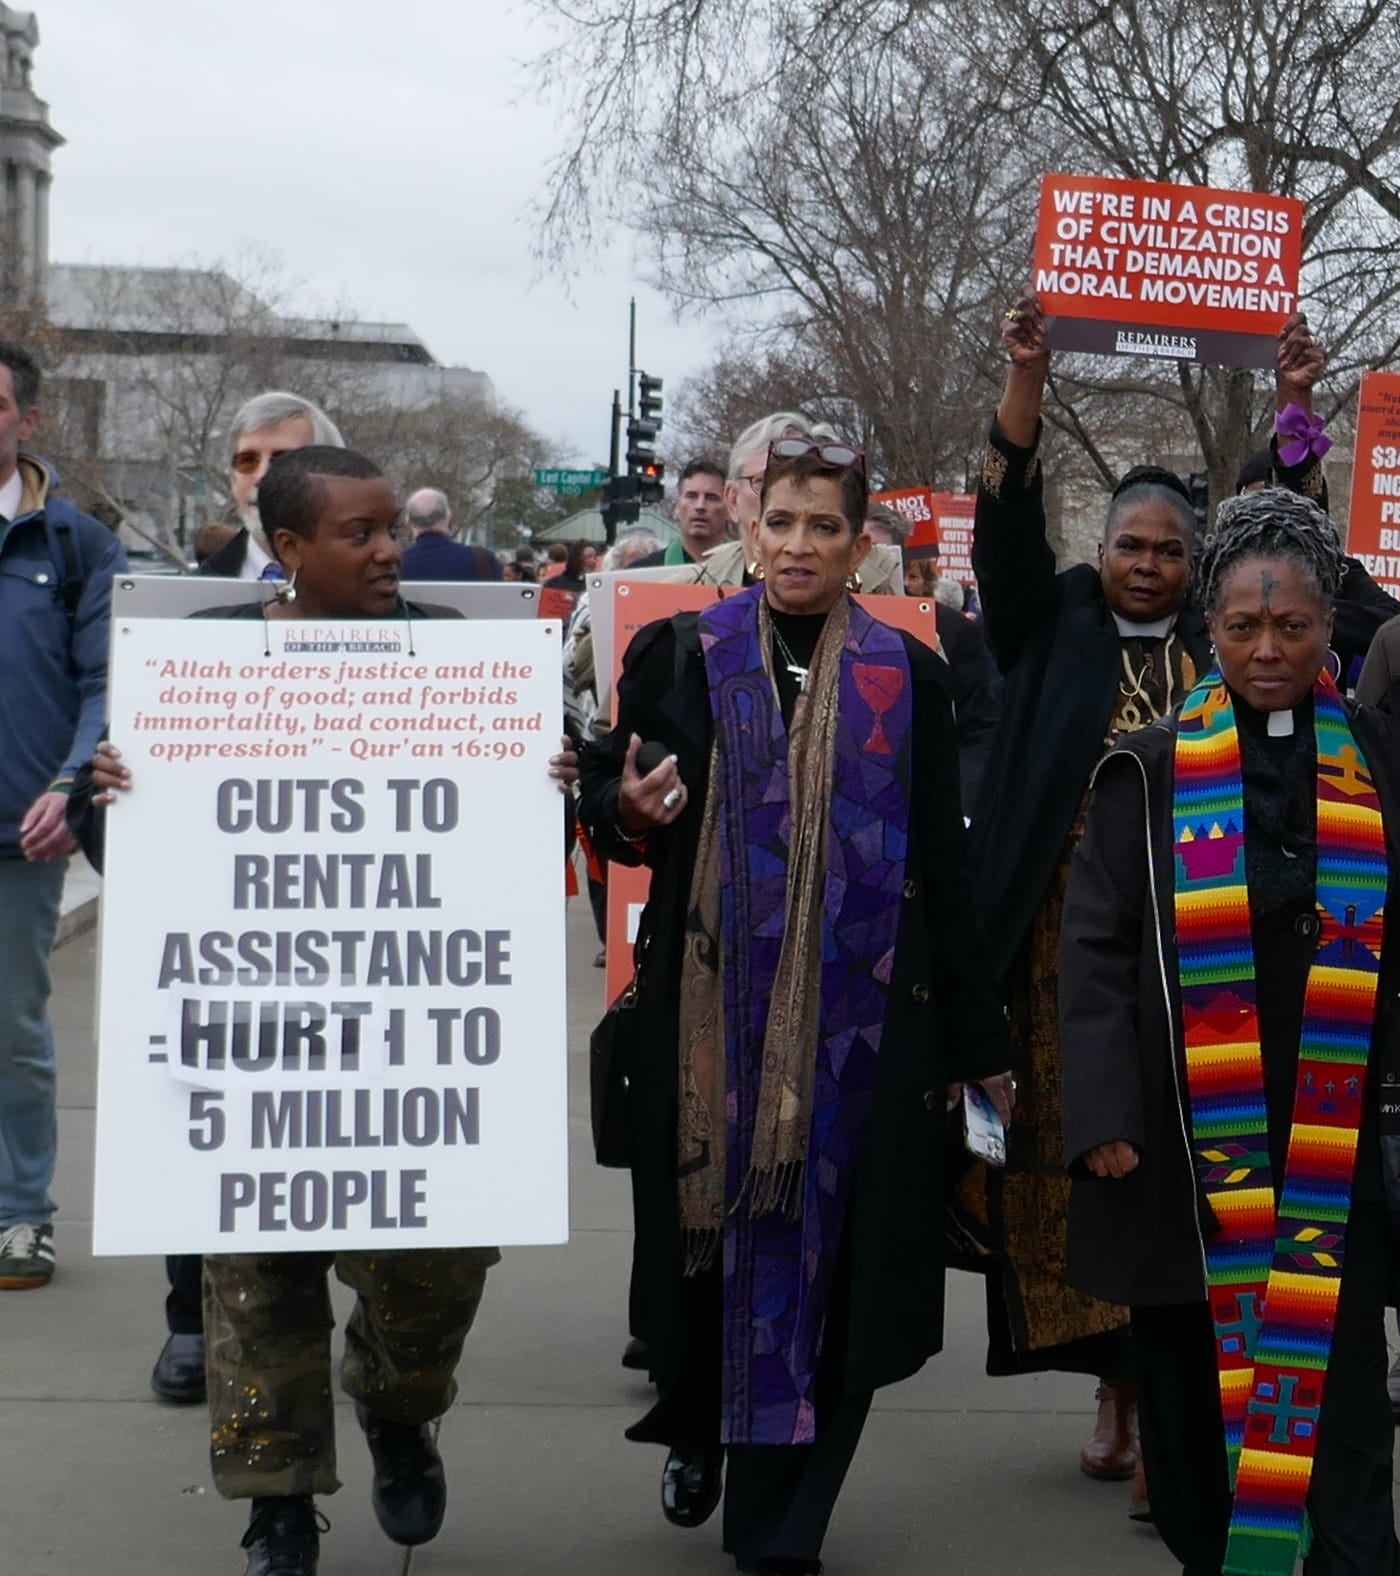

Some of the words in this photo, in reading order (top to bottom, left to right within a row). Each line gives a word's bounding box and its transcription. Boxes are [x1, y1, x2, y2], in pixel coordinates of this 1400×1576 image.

[1053, 190, 1135, 218] WE’RE
[1142, 197, 1171, 222] IN
[1177, 201, 1198, 224] A
[1205, 203, 1289, 234] CRISIS
[1057, 217, 1094, 241] OF
[1100, 221, 1281, 260] CIVILIZATION
[1050, 243, 1119, 271] THAT
[1126, 250, 1258, 284] DEMANDS
[1265, 263, 1286, 287] A
[1036, 269, 1132, 300] MORAL
[1140, 278, 1295, 315] MOVEMENT
[1117, 331, 1197, 349] REPAIRERS
[896, 494, 926, 513] NOT
[943, 530, 968, 542] CUTS
[286, 628, 401, 642] REPAIRERS
[145, 659, 232, 680] “Allah
[239, 661, 331, 680] orders
[335, 660, 428, 685] justice
[435, 661, 485, 680] and
[491, 661, 533, 680] the
[159, 686, 237, 709] doing
[245, 686, 274, 710] of
[280, 686, 355, 709] good;
[362, 687, 413, 706] and
[419, 686, 518, 710] forbids
[133, 712, 307, 737] immortality,
[314, 713, 363, 732] bad
[369, 712, 485, 735] conduct,
[492, 712, 543, 731] and
[149, 737, 324, 762] oppression”
[349, 738, 444, 761] Qur’an
[450, 741, 527, 762] 16:90
[216, 777, 366, 834] CUTS
[387, 778, 460, 834] TO
[233, 853, 442, 910] RENTAL
[157, 928, 513, 990] ASSISTANCE
[180, 997, 373, 1073] HURT
[427, 1006, 502, 1066] TO
[188, 1091, 227, 1152] 5
[250, 1086, 480, 1150] MILLION
[218, 1168, 428, 1233] PEOPLE
